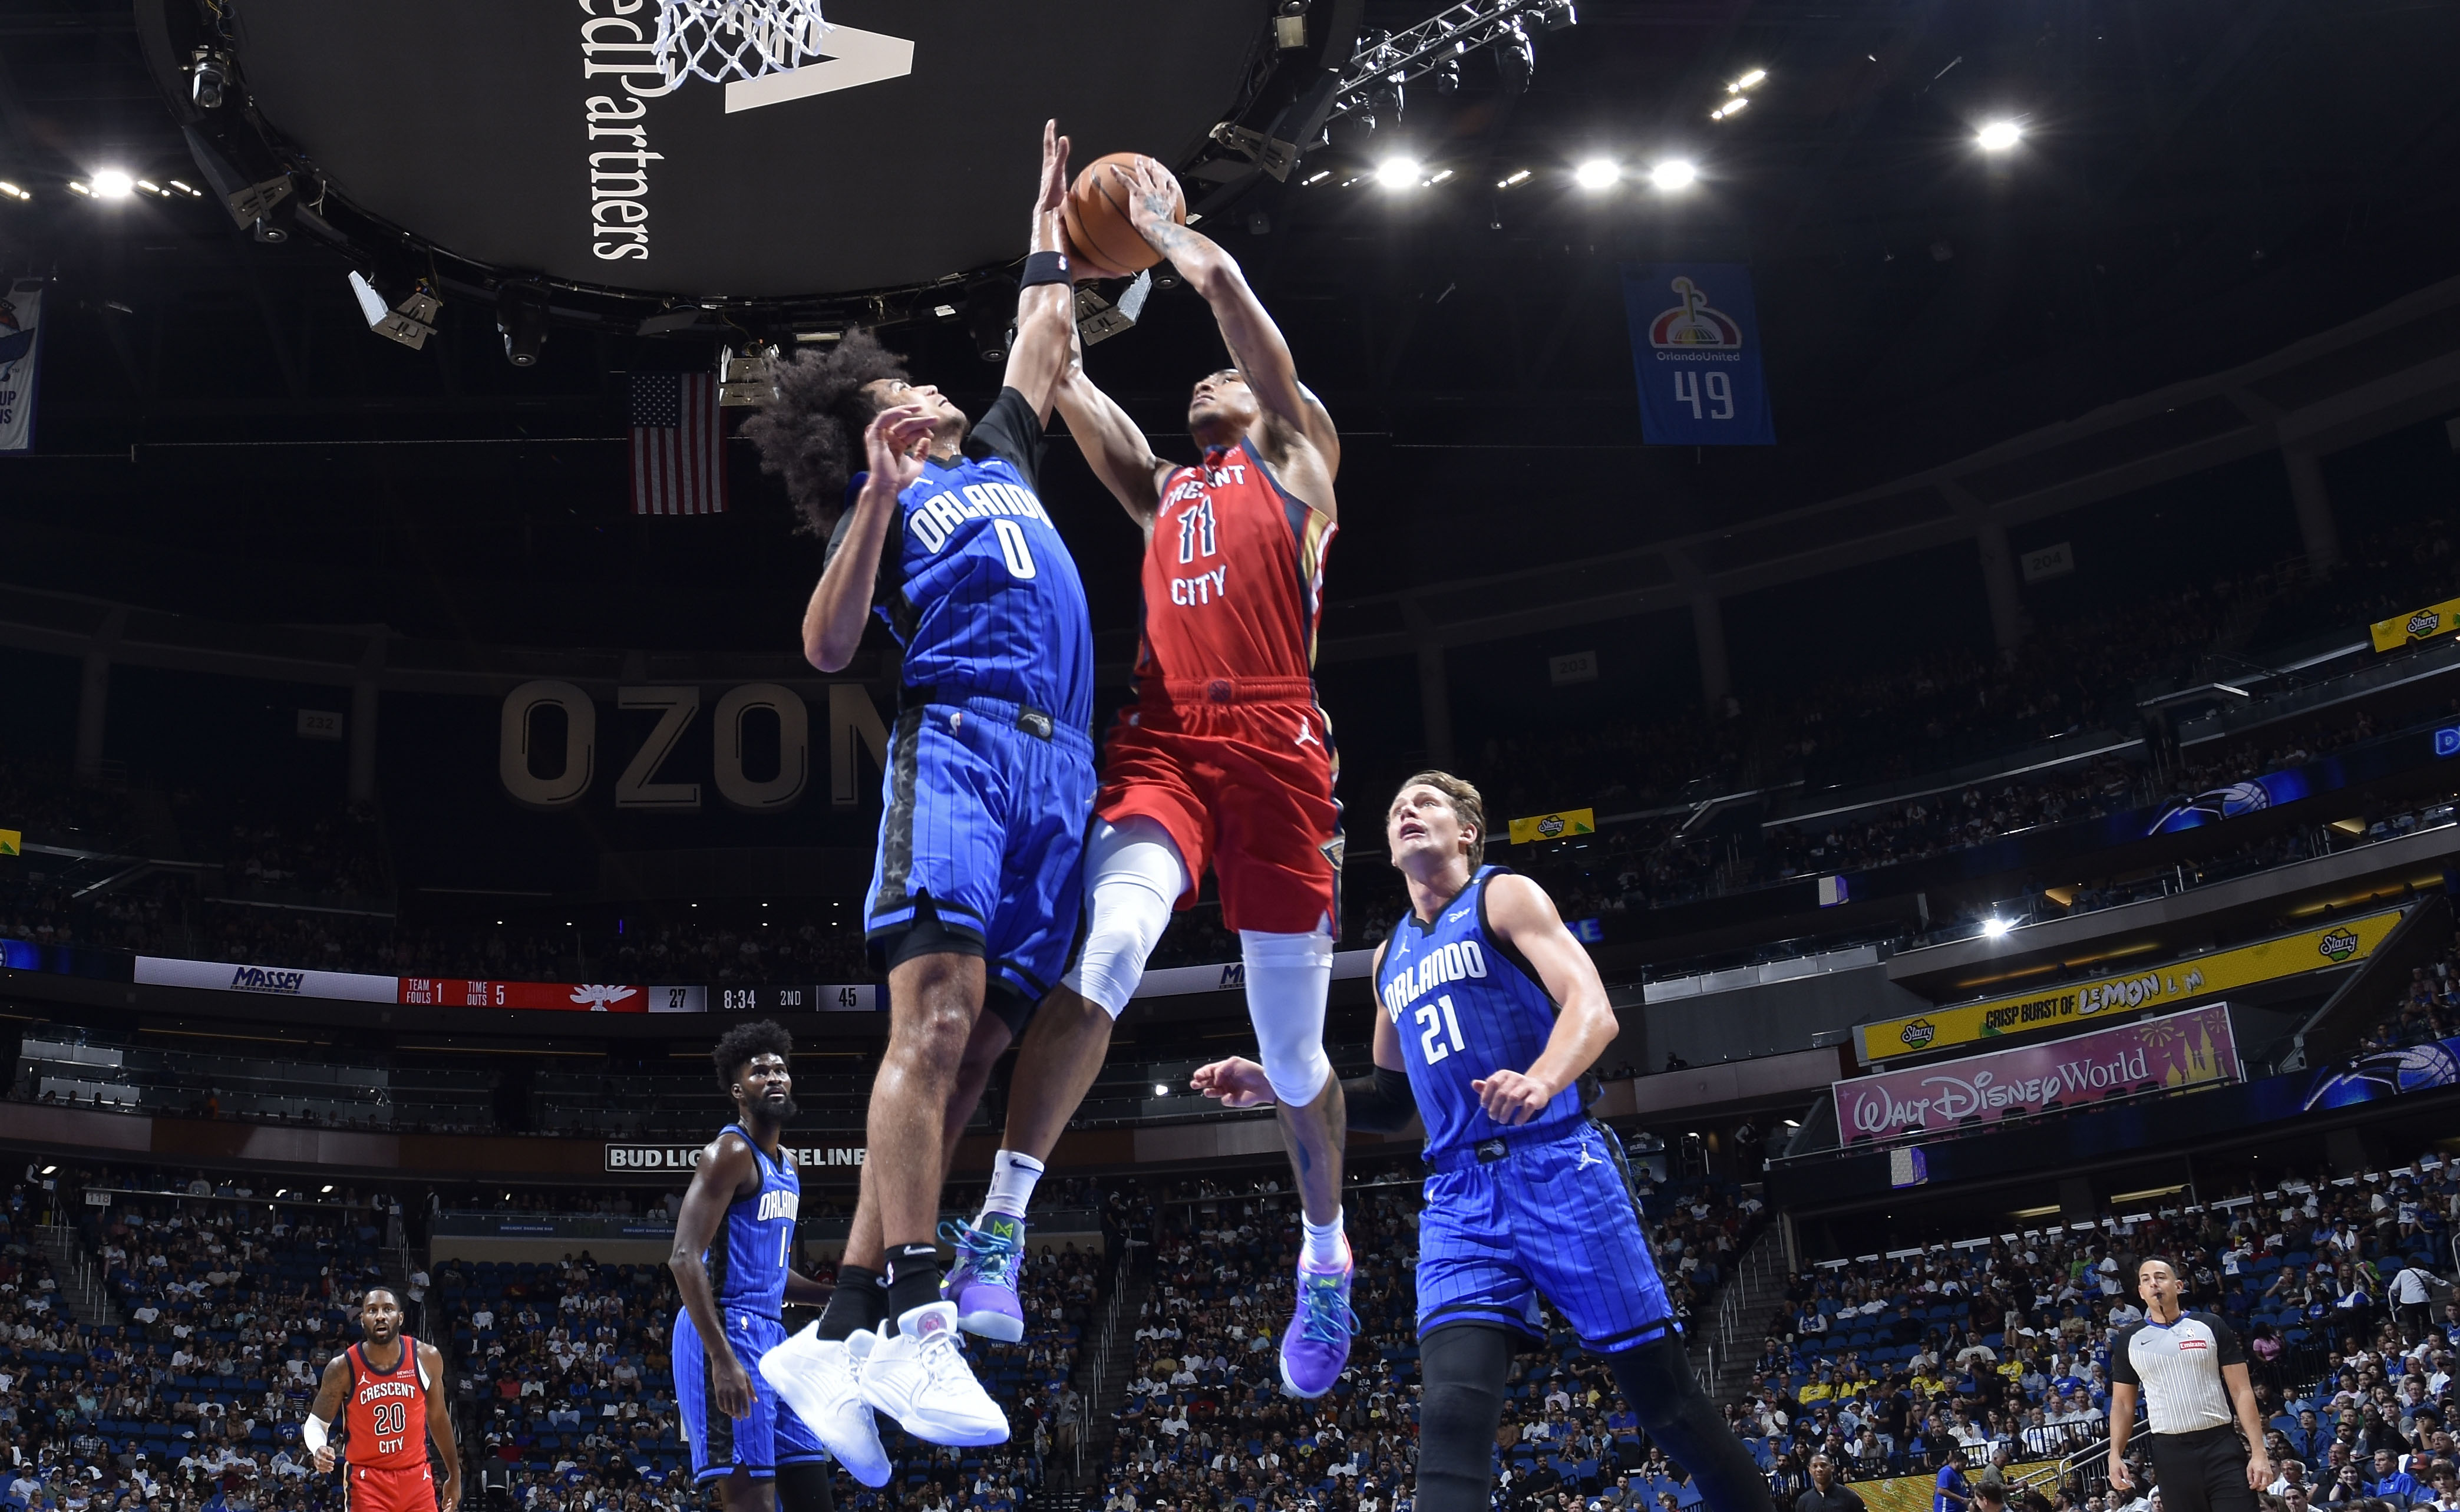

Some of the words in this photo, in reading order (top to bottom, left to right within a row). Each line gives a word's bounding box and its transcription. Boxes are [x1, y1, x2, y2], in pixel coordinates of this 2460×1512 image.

[1675, 371, 1734, 419] 49
[910, 483, 1054, 554] ORLANDO
[1177, 494, 1216, 564] 11
[994, 519, 1036, 579] 0
[2032, 552, 2062, 571] 204
[1171, 564, 1226, 606] CITY
[2407, 614, 2438, 633] Starry
[306, 717, 333, 729] 232
[1538, 820, 1564, 833] Starry
[2320, 936, 2356, 955] Starry
[232, 967, 304, 989] MASSEY
[408, 979, 430, 991] TEAM
[467, 981, 487, 993] TIME
[1385, 940, 1487, 1024] ORLANDO
[406, 991, 431, 1004] FOULS
[435, 982, 443, 1003] 1
[467, 994, 487, 1006] OUTS
[496, 985, 504, 1005] 5
[669, 989, 686, 1008] 27
[723, 990, 756, 1009] 8:34
[780, 989, 801, 1006] 2ND
[838, 988, 857, 1007] 45
[1986, 1006, 2020, 1029] CRISP
[2020, 998, 2058, 1023] BURST
[2061, 995, 2075, 1015] OF
[2077, 973, 2159, 1015] LEMON
[1415, 995, 1465, 1065] 21
[1901, 1022, 1934, 1042] Starry
[2057, 1048, 2150, 1095] World
[610, 1148, 663, 1167] BUD
[88, 1193, 110, 1203] 118
[778, 1226, 787, 1267] 1
[360, 1382, 415, 1405] CRESCENT
[373, 1402, 406, 1436] 20
[379, 1436, 404, 1454] CITY
